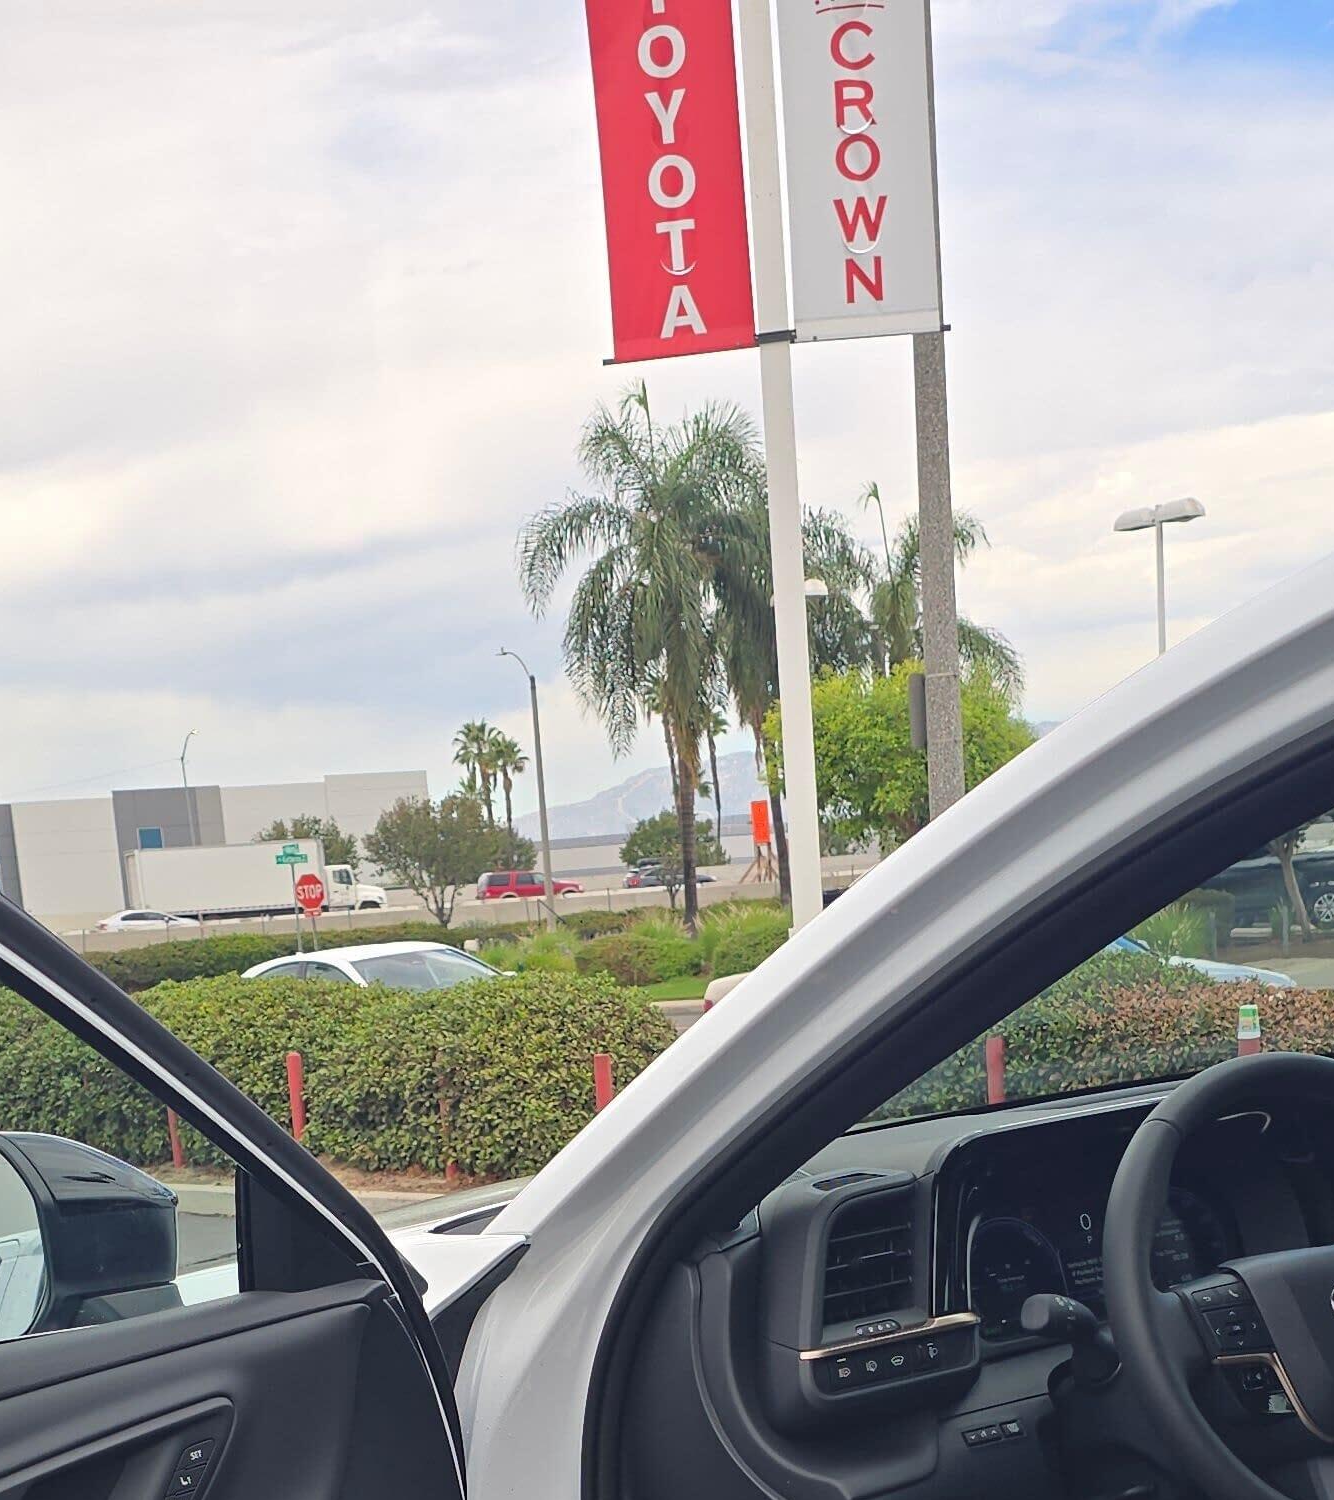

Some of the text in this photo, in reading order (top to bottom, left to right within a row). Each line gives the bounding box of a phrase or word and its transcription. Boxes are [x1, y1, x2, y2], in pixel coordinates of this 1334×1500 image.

[638, 0, 707, 339] OYOTA
[829, 20, 888, 304] CROWN
[297, 884, 322, 900] STOP
[1080, 1213, 1092, 1230] 0
